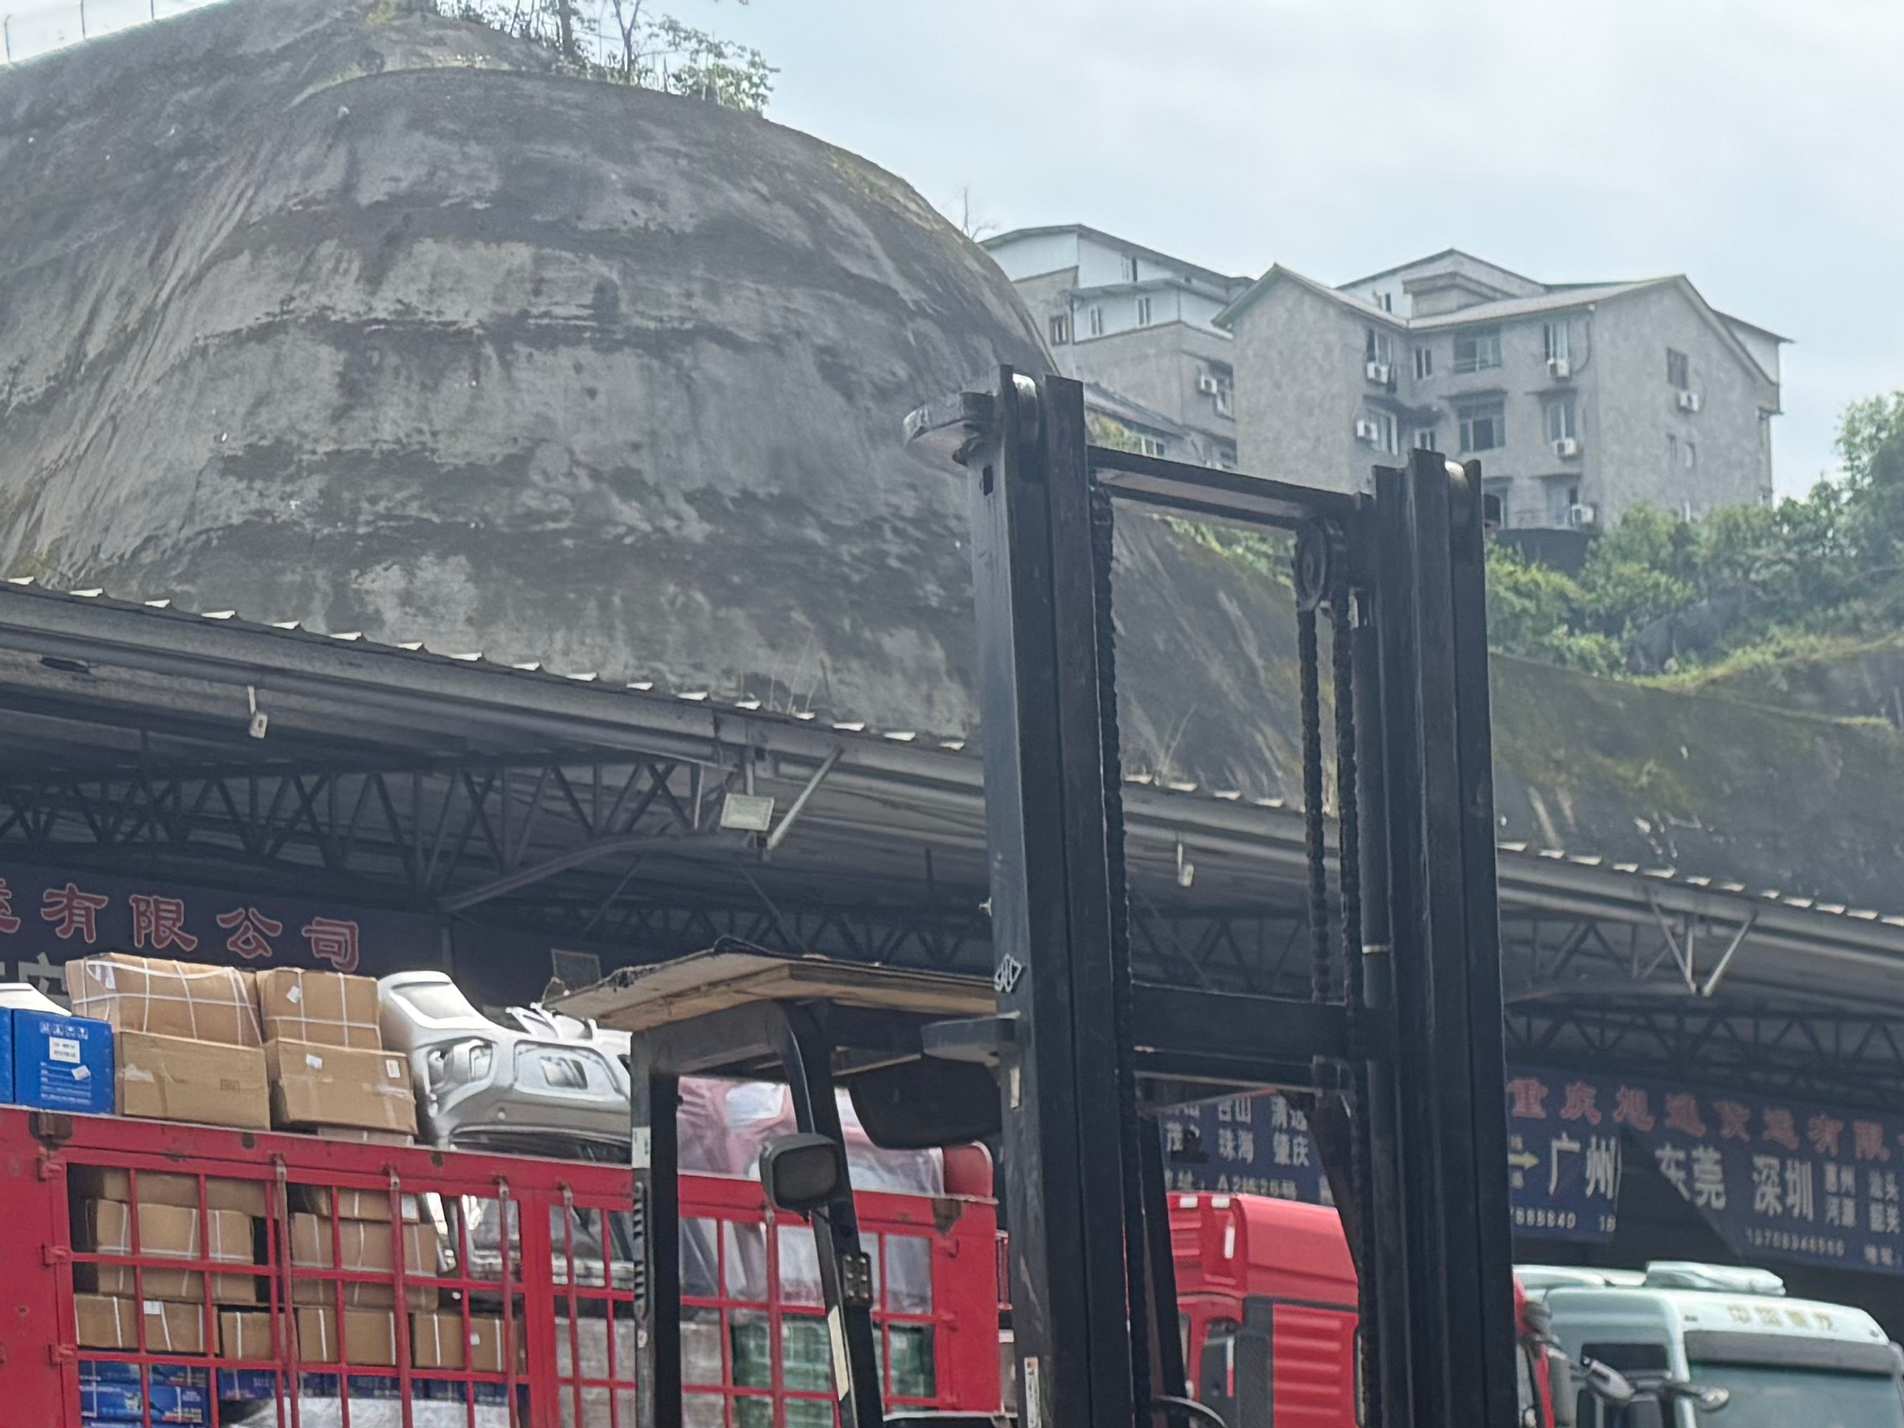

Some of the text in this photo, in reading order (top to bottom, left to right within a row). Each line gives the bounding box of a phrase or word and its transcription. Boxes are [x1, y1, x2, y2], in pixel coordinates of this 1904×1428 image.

[1549, 1131, 1616, 1200] 广州
[1654, 1143, 1726, 1211] 东莞
[1752, 1152, 1814, 1223] 深圳
